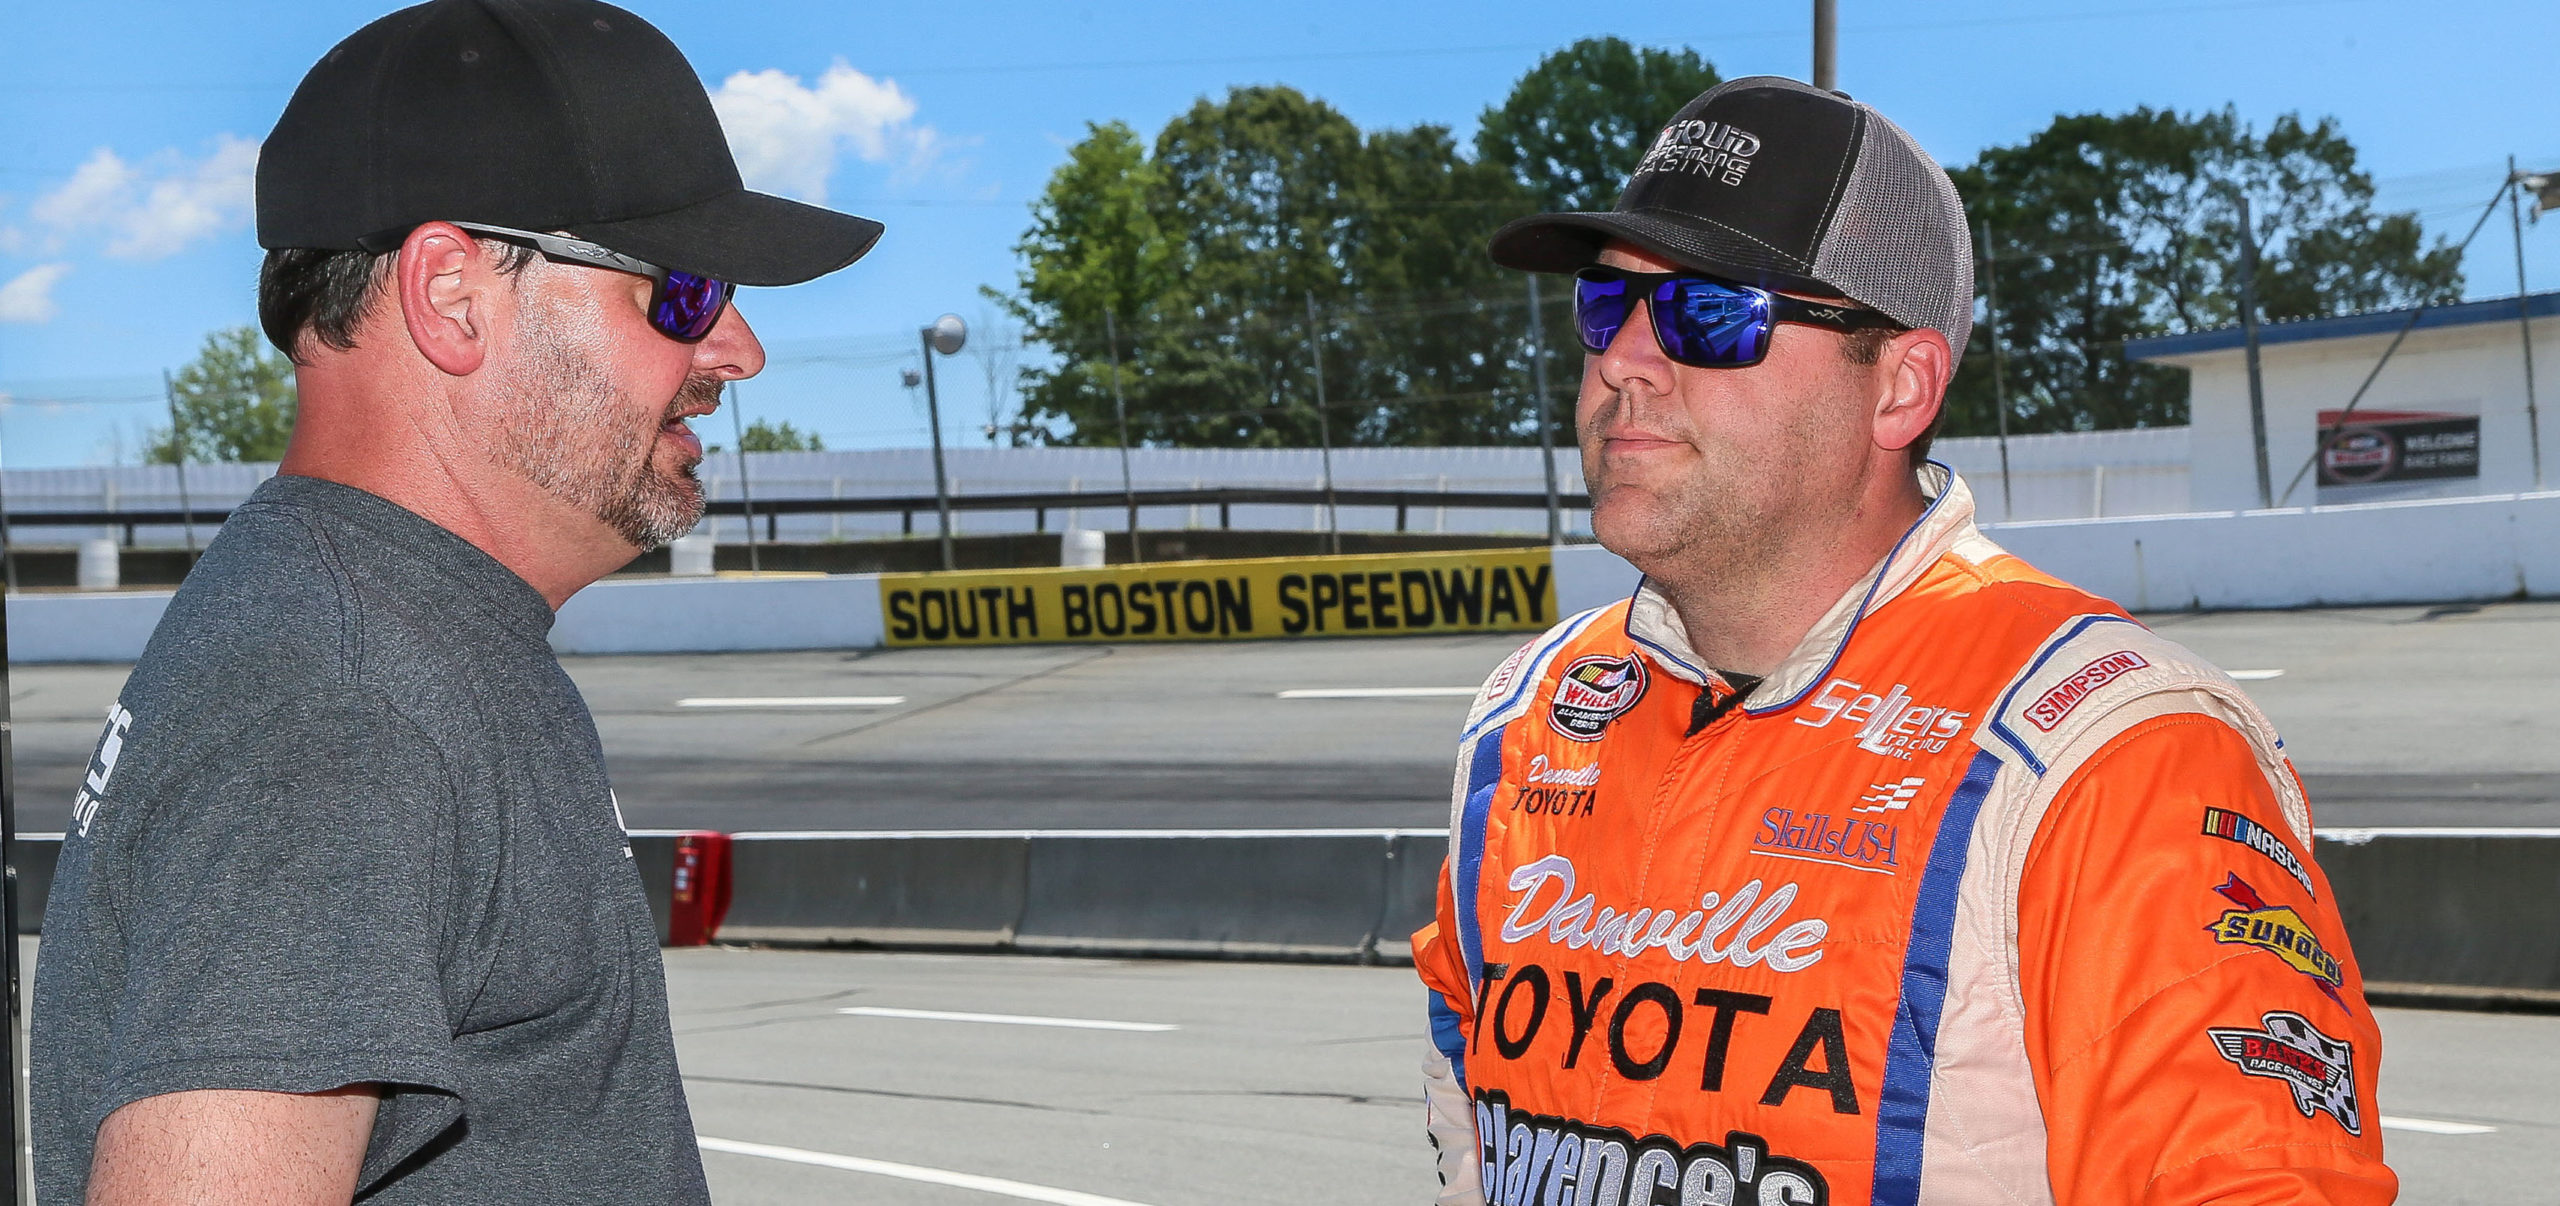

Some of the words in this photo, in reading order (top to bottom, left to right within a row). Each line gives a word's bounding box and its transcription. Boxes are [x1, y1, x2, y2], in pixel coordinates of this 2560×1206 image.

[891, 585, 1040, 641] SOUTH
[1061, 576, 1253, 637] BOSTON
[1276, 564, 1553, 634] SPEEDWAY
[2035, 654, 2137, 722] SIMPSON
[1510, 786, 1597, 818] TOYOTA
[1754, 806, 1899, 867] SkillsUSA
[2246, 821, 2315, 898] NASCAR
[1500, 854, 1830, 973] Danville
[2227, 915, 2341, 983] SUNOCO
[1472, 962, 1862, 1116] TOYOTA
[2244, 1038, 2327, 1081] BANKS
